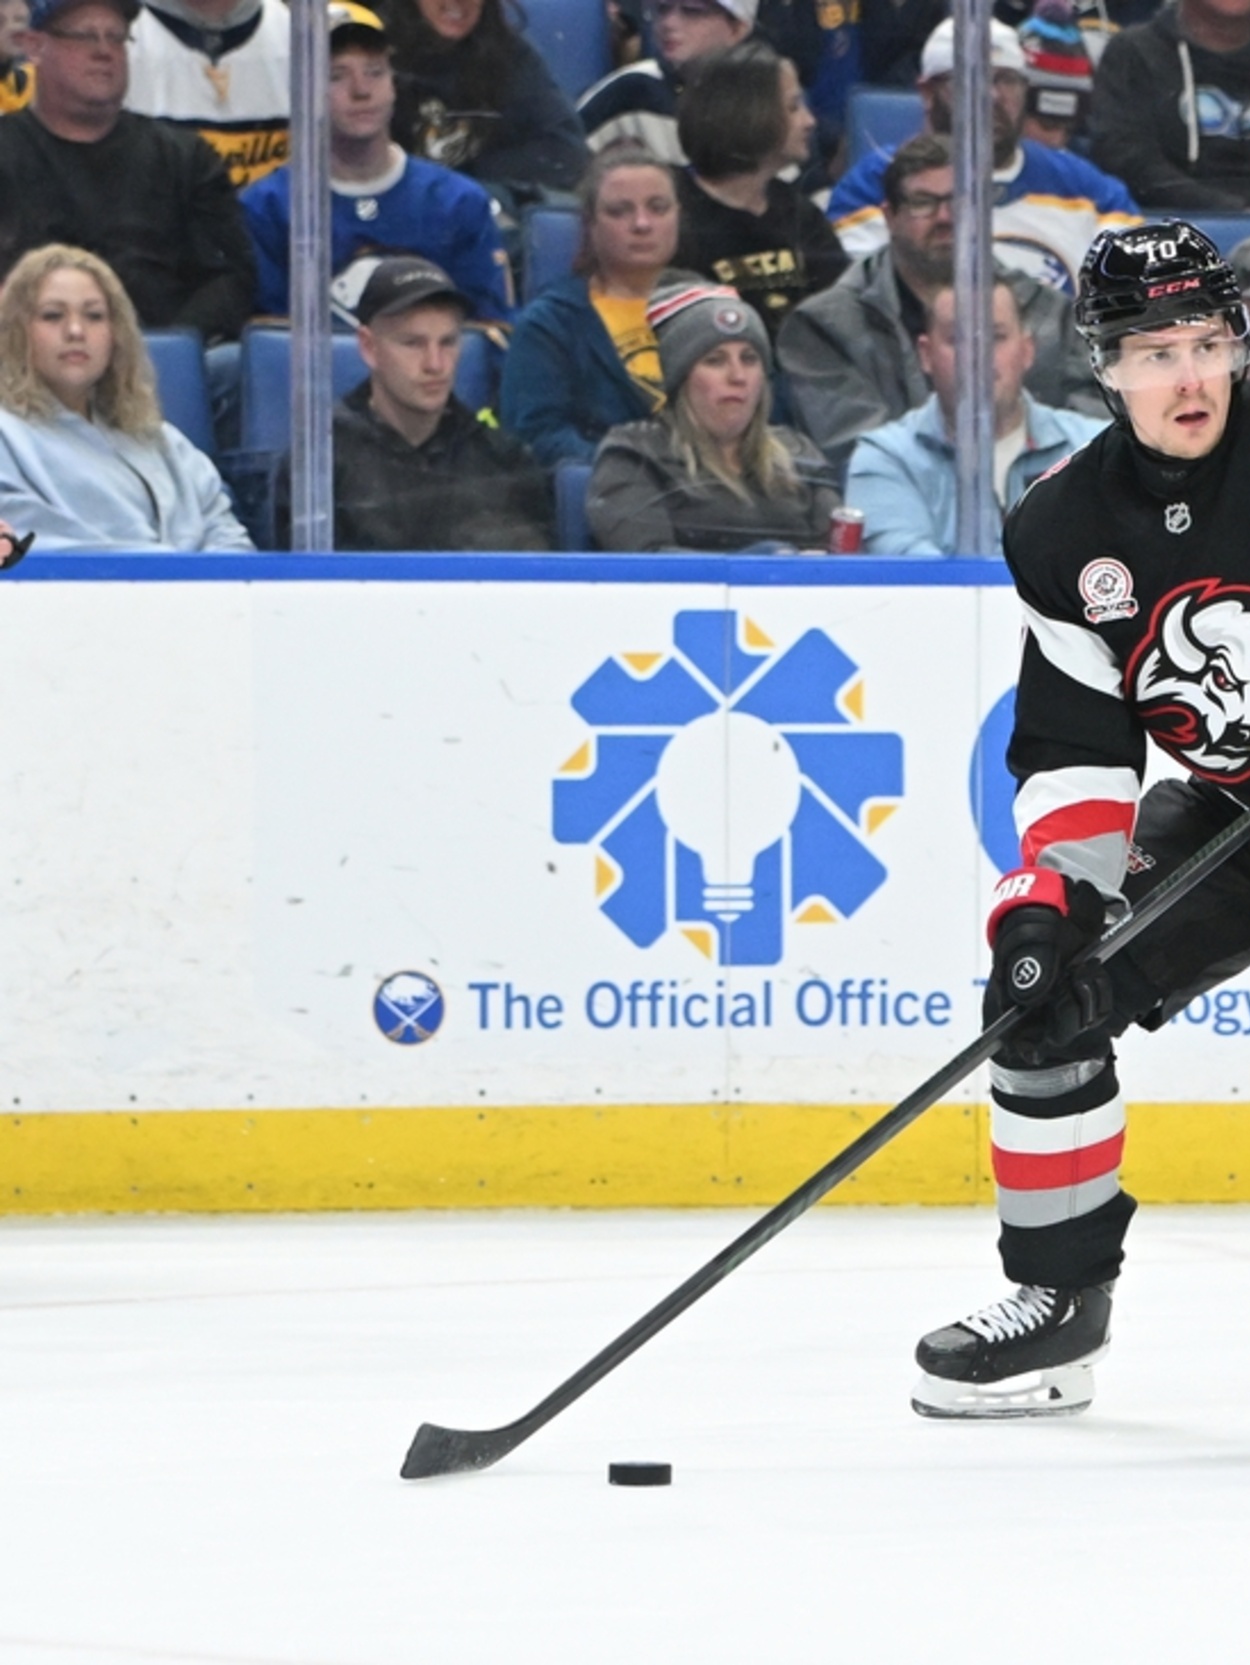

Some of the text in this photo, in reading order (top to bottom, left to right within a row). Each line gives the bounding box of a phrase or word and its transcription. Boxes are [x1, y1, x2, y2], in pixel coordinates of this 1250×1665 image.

[1145, 239, 1178, 263] 10
[1146, 277, 1201, 298] CCM
[467, 982, 564, 1030] The
[585, 980, 772, 1029] Official
[795, 979, 952, 1028] Office
